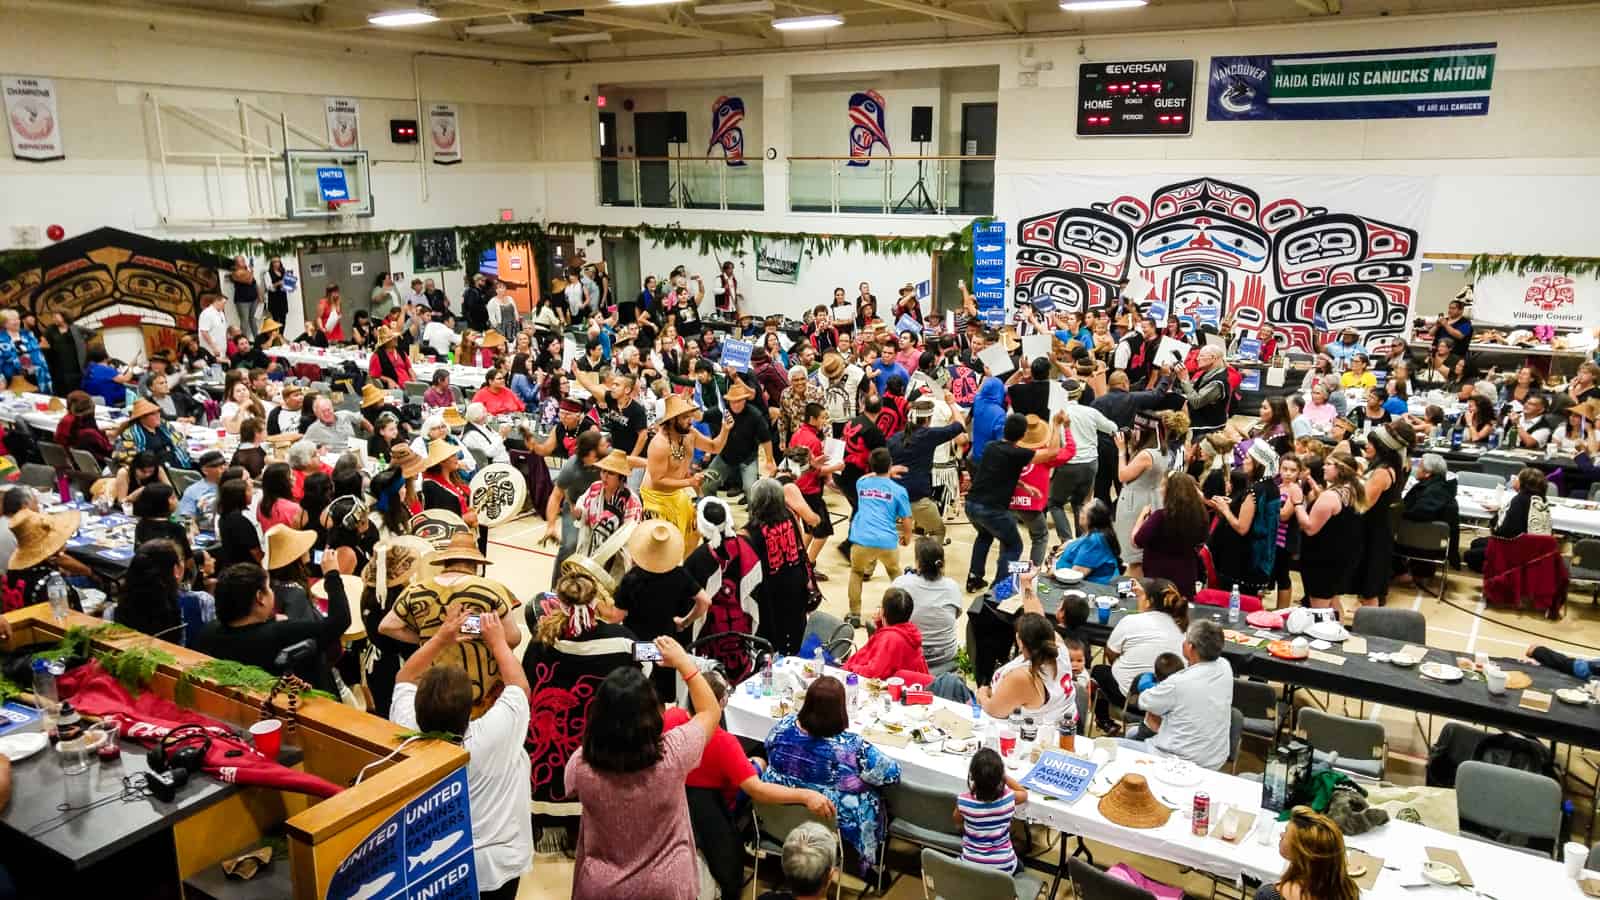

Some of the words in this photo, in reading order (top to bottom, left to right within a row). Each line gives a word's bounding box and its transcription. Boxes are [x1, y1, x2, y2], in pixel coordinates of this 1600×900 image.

[1114, 63, 1167, 74] EVERSAN
[1213, 64, 1267, 81] VANCOUVER
[1274, 74, 1308, 88] HAIDA
[1311, 72, 1345, 87] GWAII
[1348, 71, 1360, 86] IS
[1363, 68, 1429, 85] CANUCKS
[1433, 65, 1487, 82] NATION
[1084, 99, 1113, 109] HOME
[1154, 97, 1187, 108] GUEST
[1427, 104, 1438, 112] ARE
[1439, 103, 1449, 111] ALL
[1450, 102, 1483, 111] CANUCKS
[976, 225, 1003, 233] UTED
[976, 291, 1003, 299] UNITED
[1513, 311, 1544, 321] Village
[1546, 311, 1583, 321] Council
[1038, 767, 1085, 785] AGAINST
[1044, 758, 1089, 776] UNITED
[1035, 773, 1079, 791] TANKERS
[406, 782, 462, 824] UNITED
[407, 799, 463, 837] AGAINST
[407, 810, 465, 848] TANKERS
[339, 822, 398, 872] UNITED
